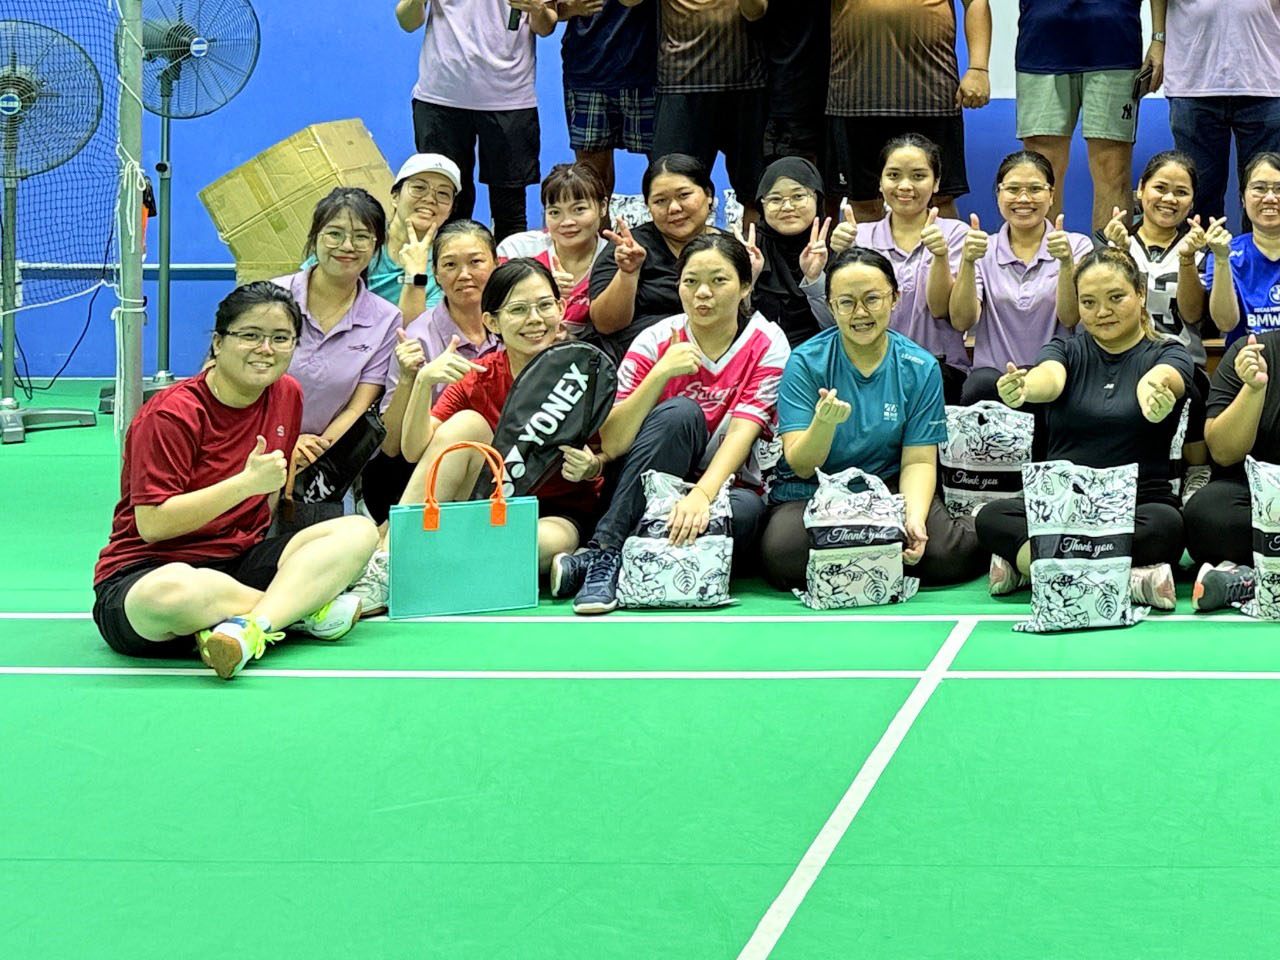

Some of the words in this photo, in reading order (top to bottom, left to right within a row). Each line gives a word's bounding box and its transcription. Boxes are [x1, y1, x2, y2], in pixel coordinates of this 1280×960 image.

[1248, 314, 1280, 327] BMW
[518, 362, 589, 446] YONEX
[827, 527, 866, 543] Thank
[1060, 537, 1093, 553] Thank
[1092, 543, 1114, 558] you
